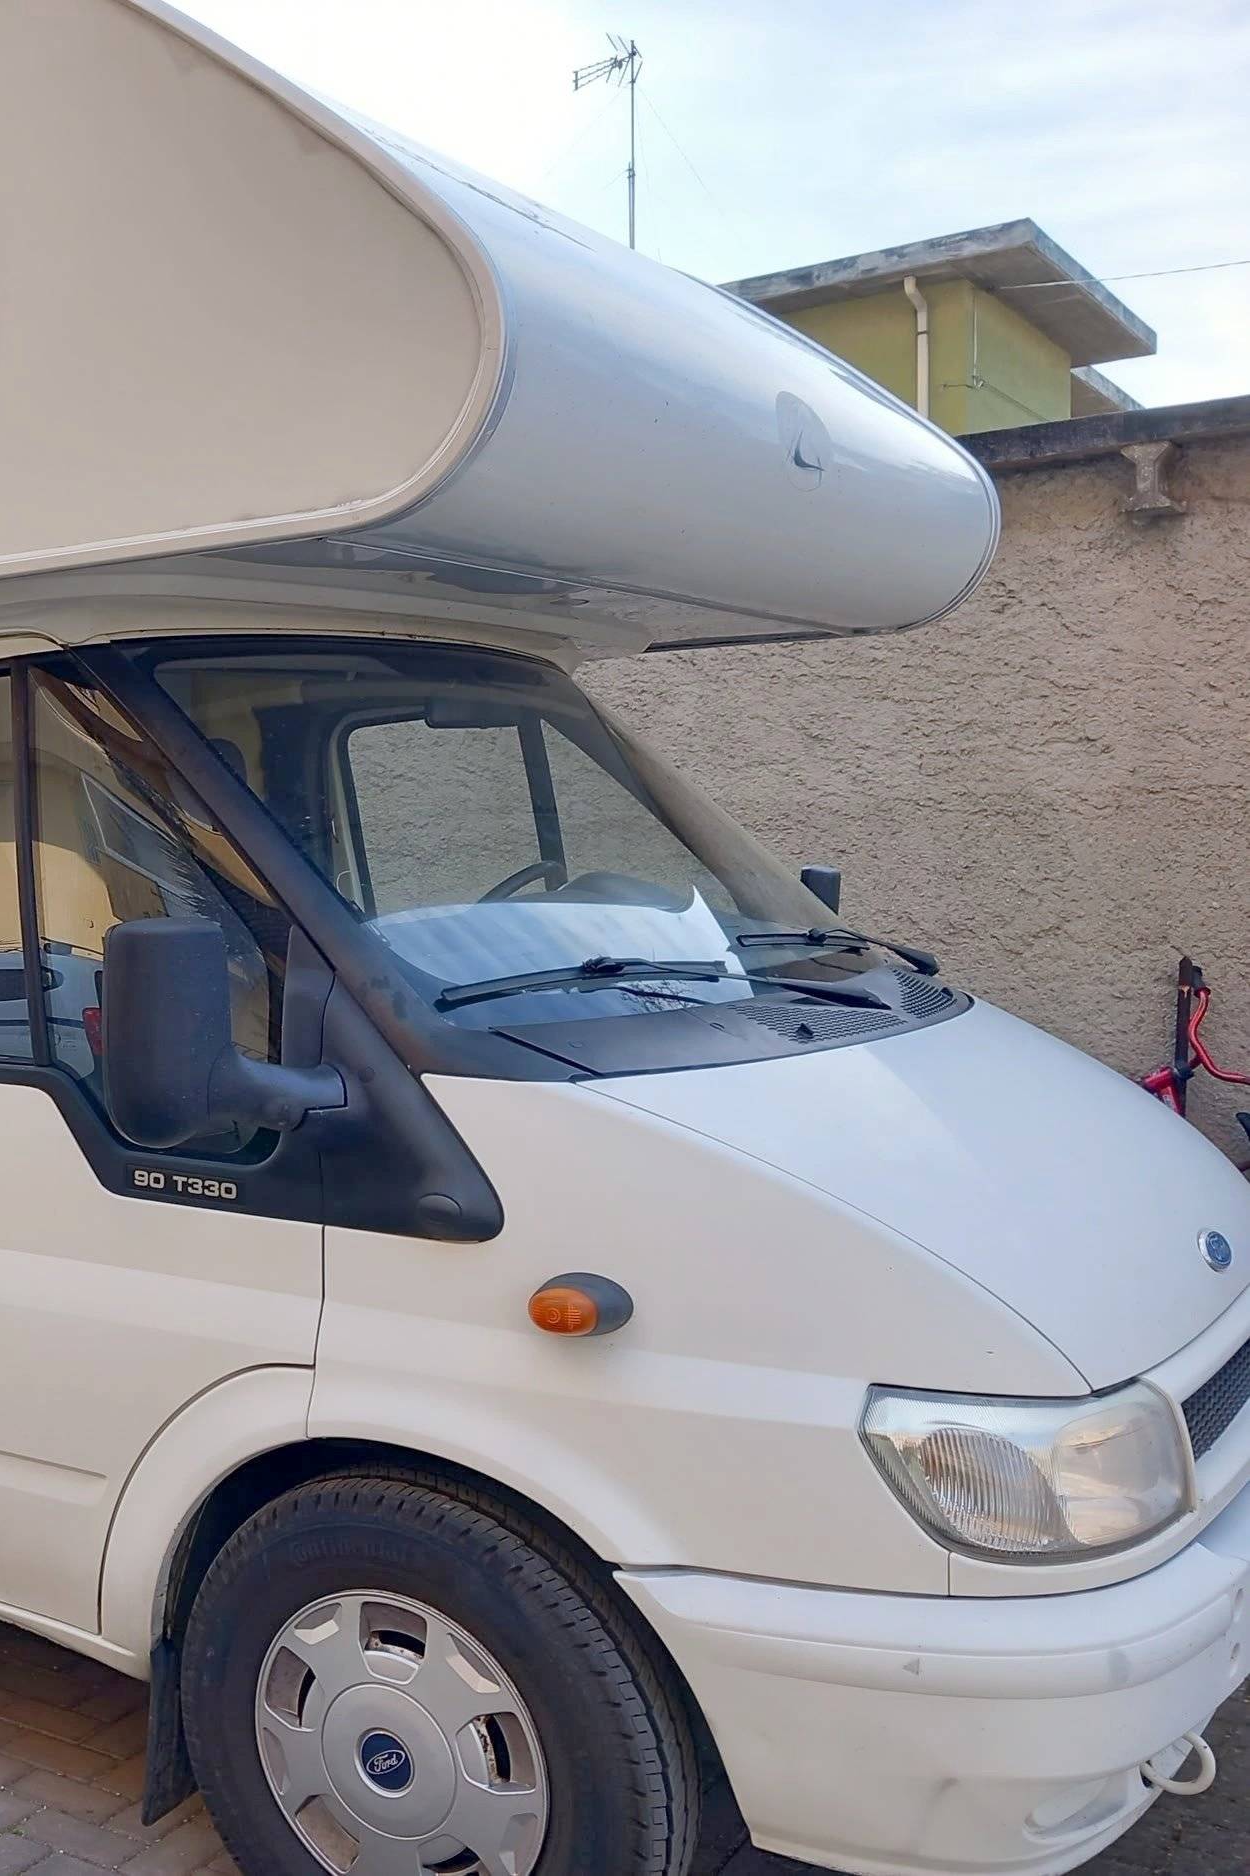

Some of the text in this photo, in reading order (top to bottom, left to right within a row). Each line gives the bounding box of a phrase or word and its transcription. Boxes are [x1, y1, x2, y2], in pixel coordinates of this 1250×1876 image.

[133, 1169, 238, 1200] 90 T330
[373, 1753, 399, 1773] Ford
